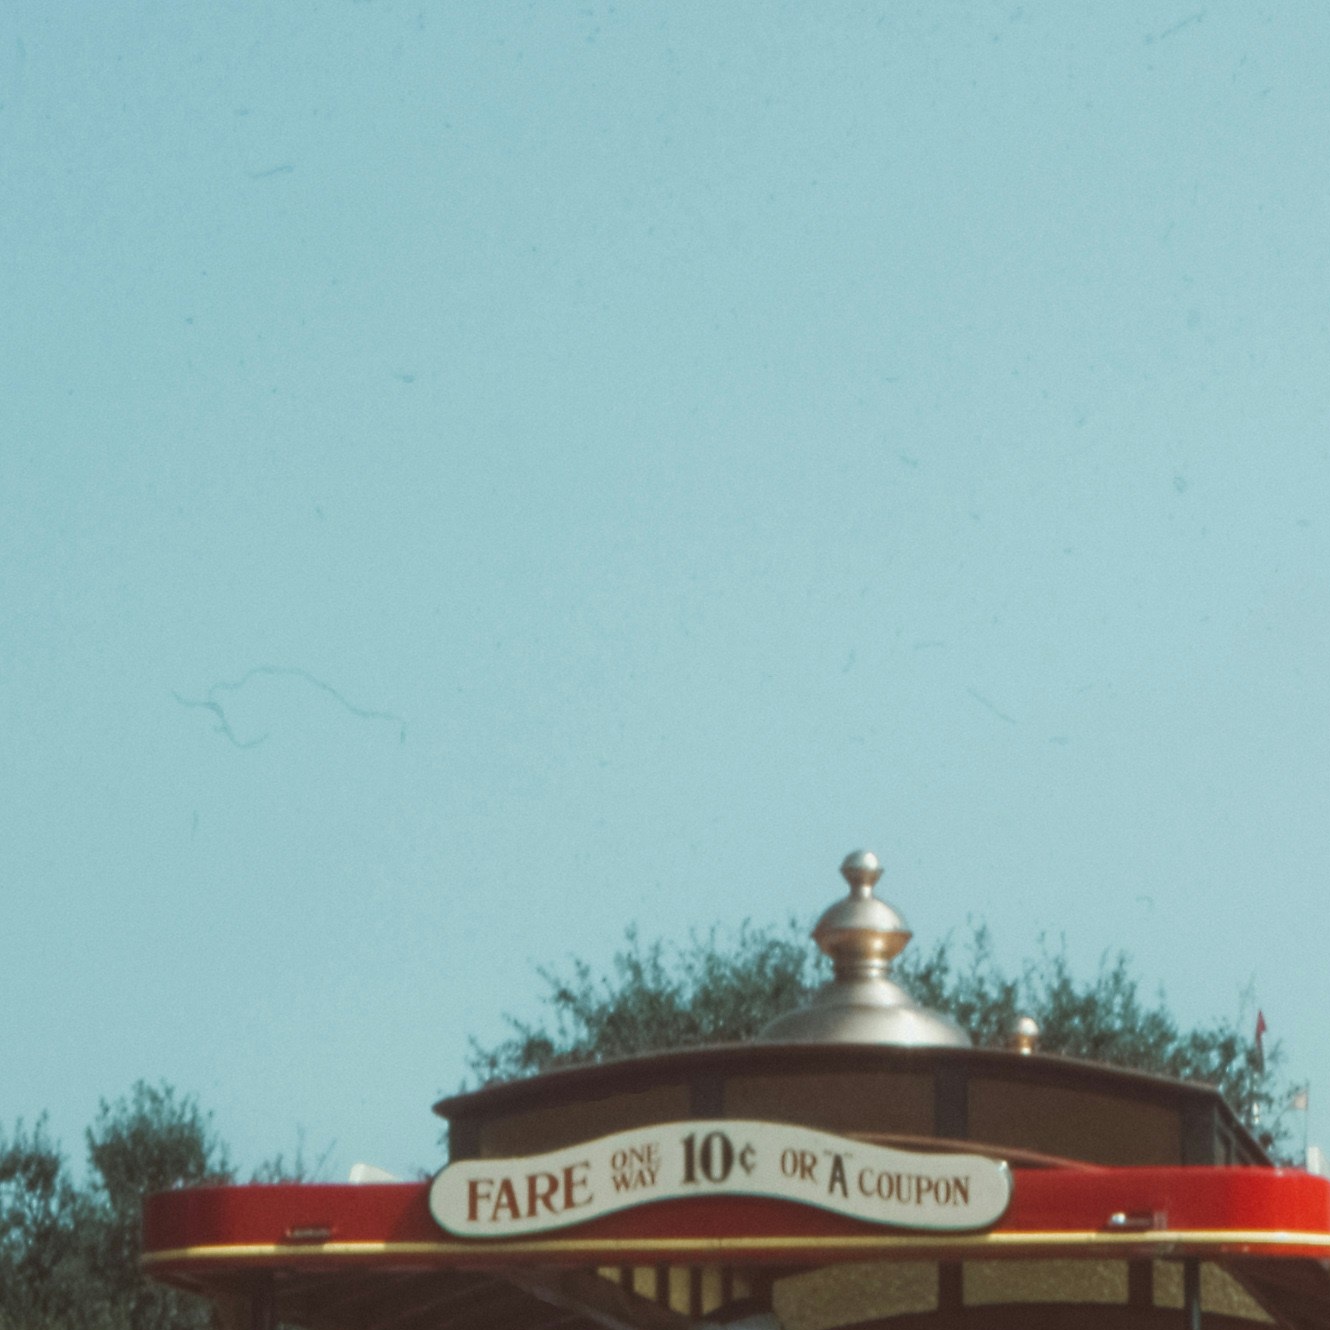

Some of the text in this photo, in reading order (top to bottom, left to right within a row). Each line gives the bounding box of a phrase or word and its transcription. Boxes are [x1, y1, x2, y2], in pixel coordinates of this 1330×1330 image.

[611, 1142, 660, 1171] ONE
[780, 1149, 817, 1183] OR
[467, 1160, 594, 1223] FARE
[611, 1160, 660, 1194] WAY
[858, 1168, 970, 1207] COUPON
